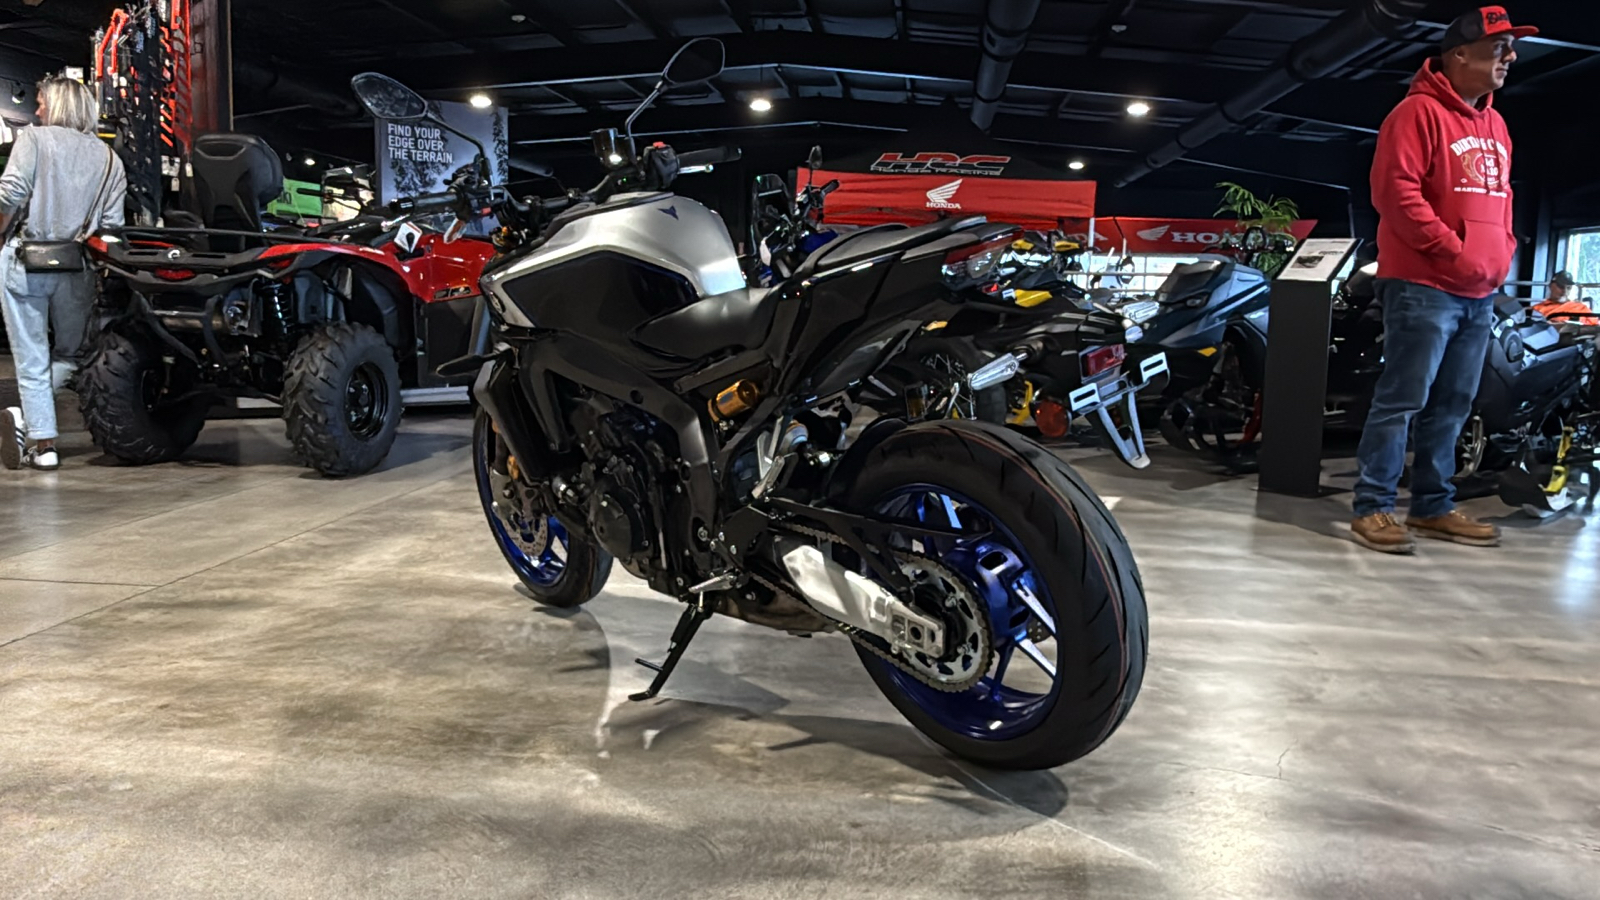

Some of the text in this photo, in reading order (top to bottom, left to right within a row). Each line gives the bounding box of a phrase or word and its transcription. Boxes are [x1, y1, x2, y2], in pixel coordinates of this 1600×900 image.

[388, 124, 441, 139] FIND YOUR
[388, 136, 443, 150] EDGE OVER
[388, 148, 408, 159] THE
[870, 152, 1012, 173] HRC
